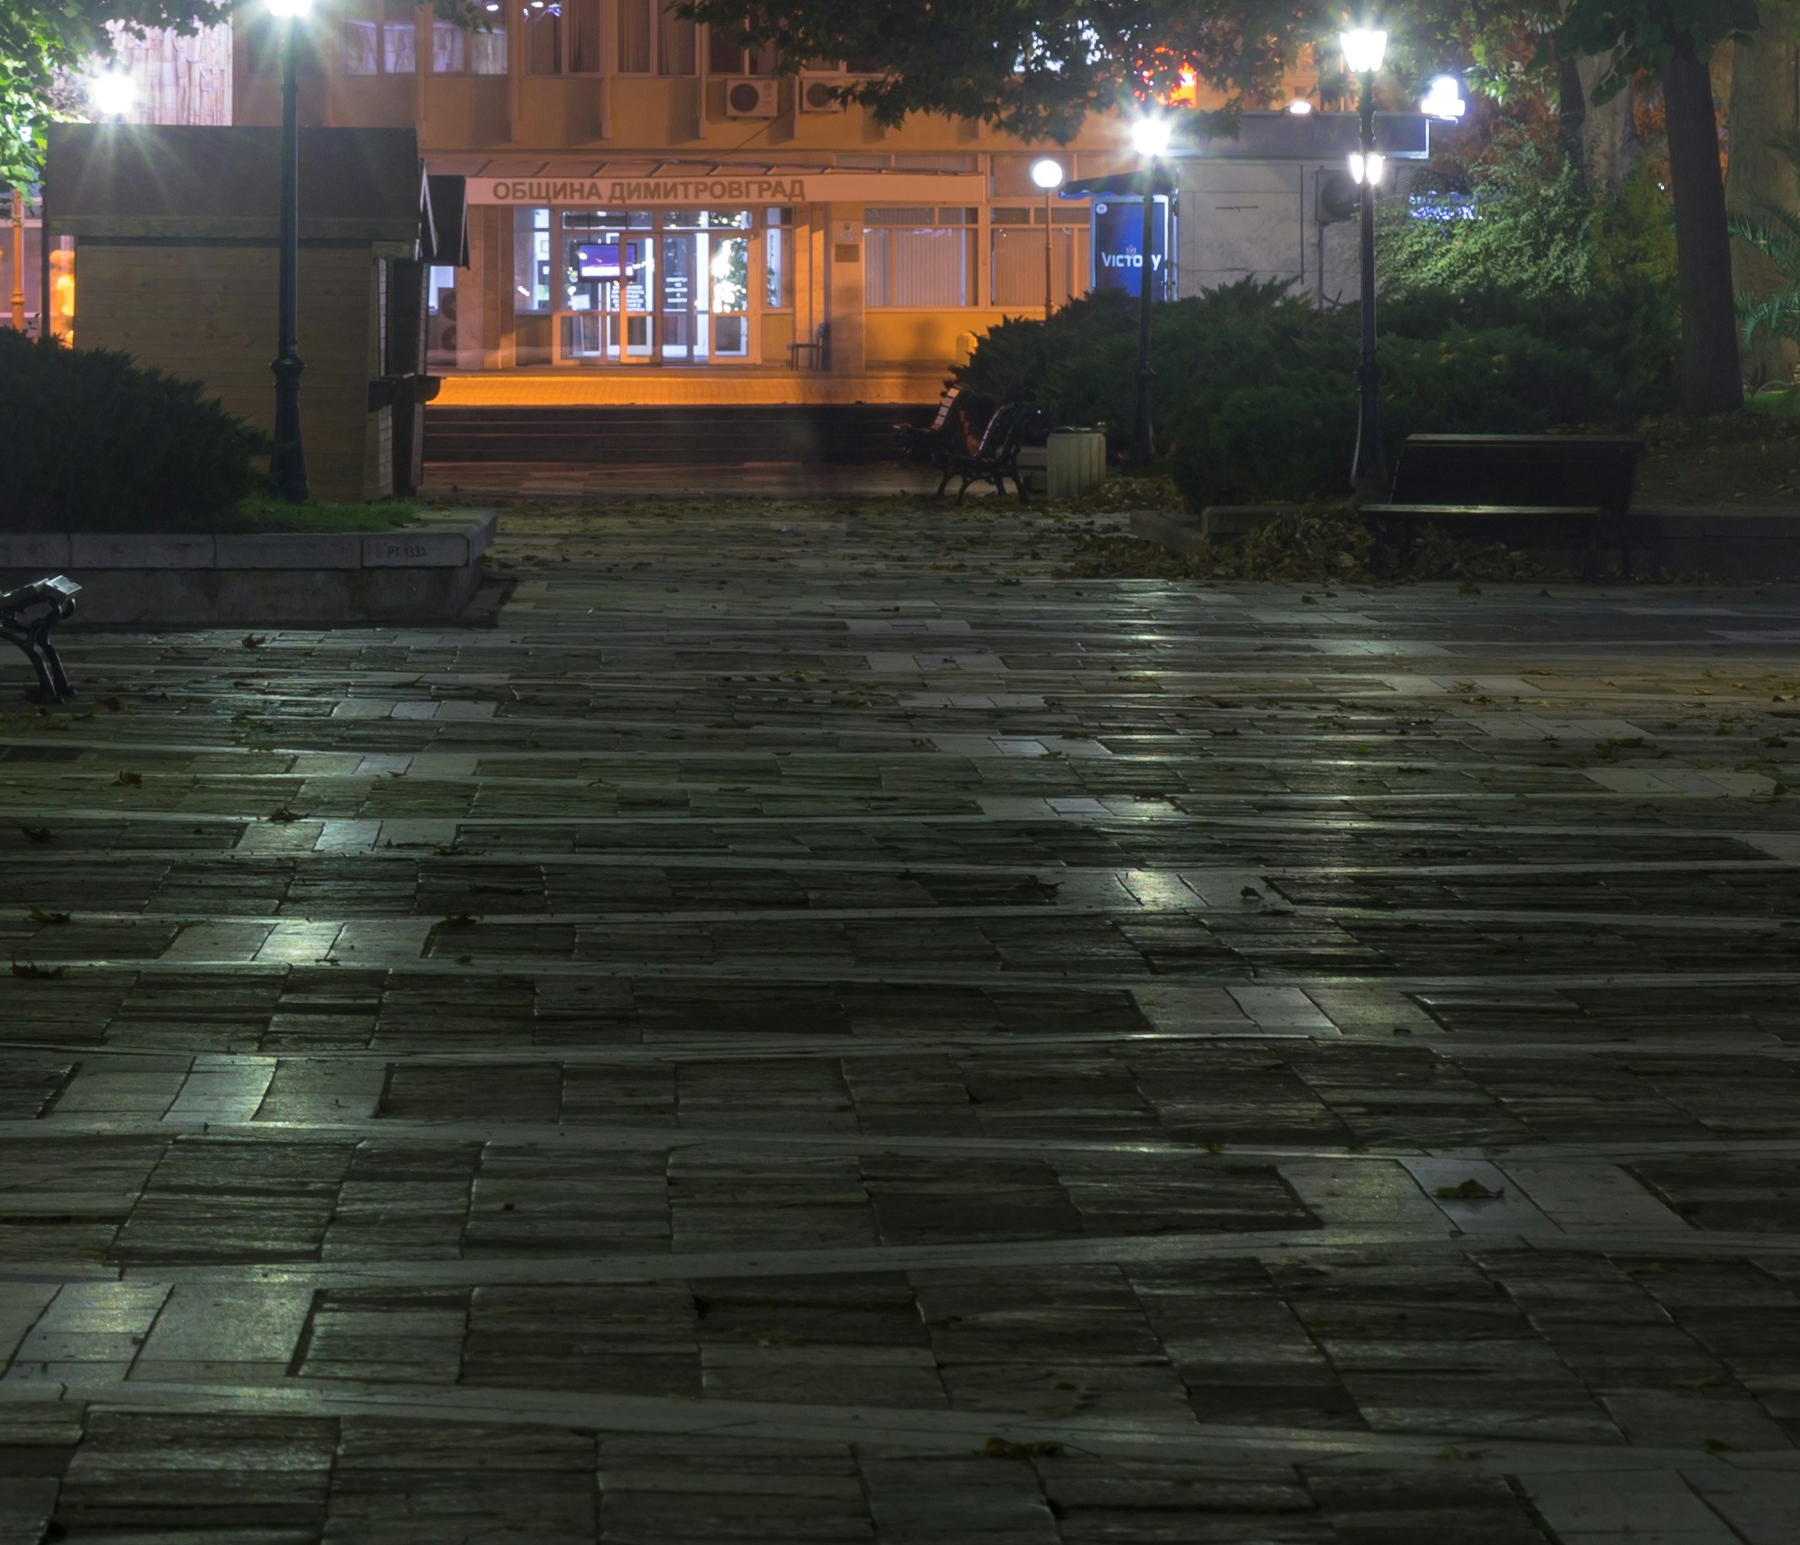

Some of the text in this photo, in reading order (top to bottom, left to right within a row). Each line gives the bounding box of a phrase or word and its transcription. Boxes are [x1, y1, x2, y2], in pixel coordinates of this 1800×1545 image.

[493, 179, 805, 203] ОБЩИНА ДИМИТРОВГРАД
[1101, 251, 1162, 271] VICTOY
